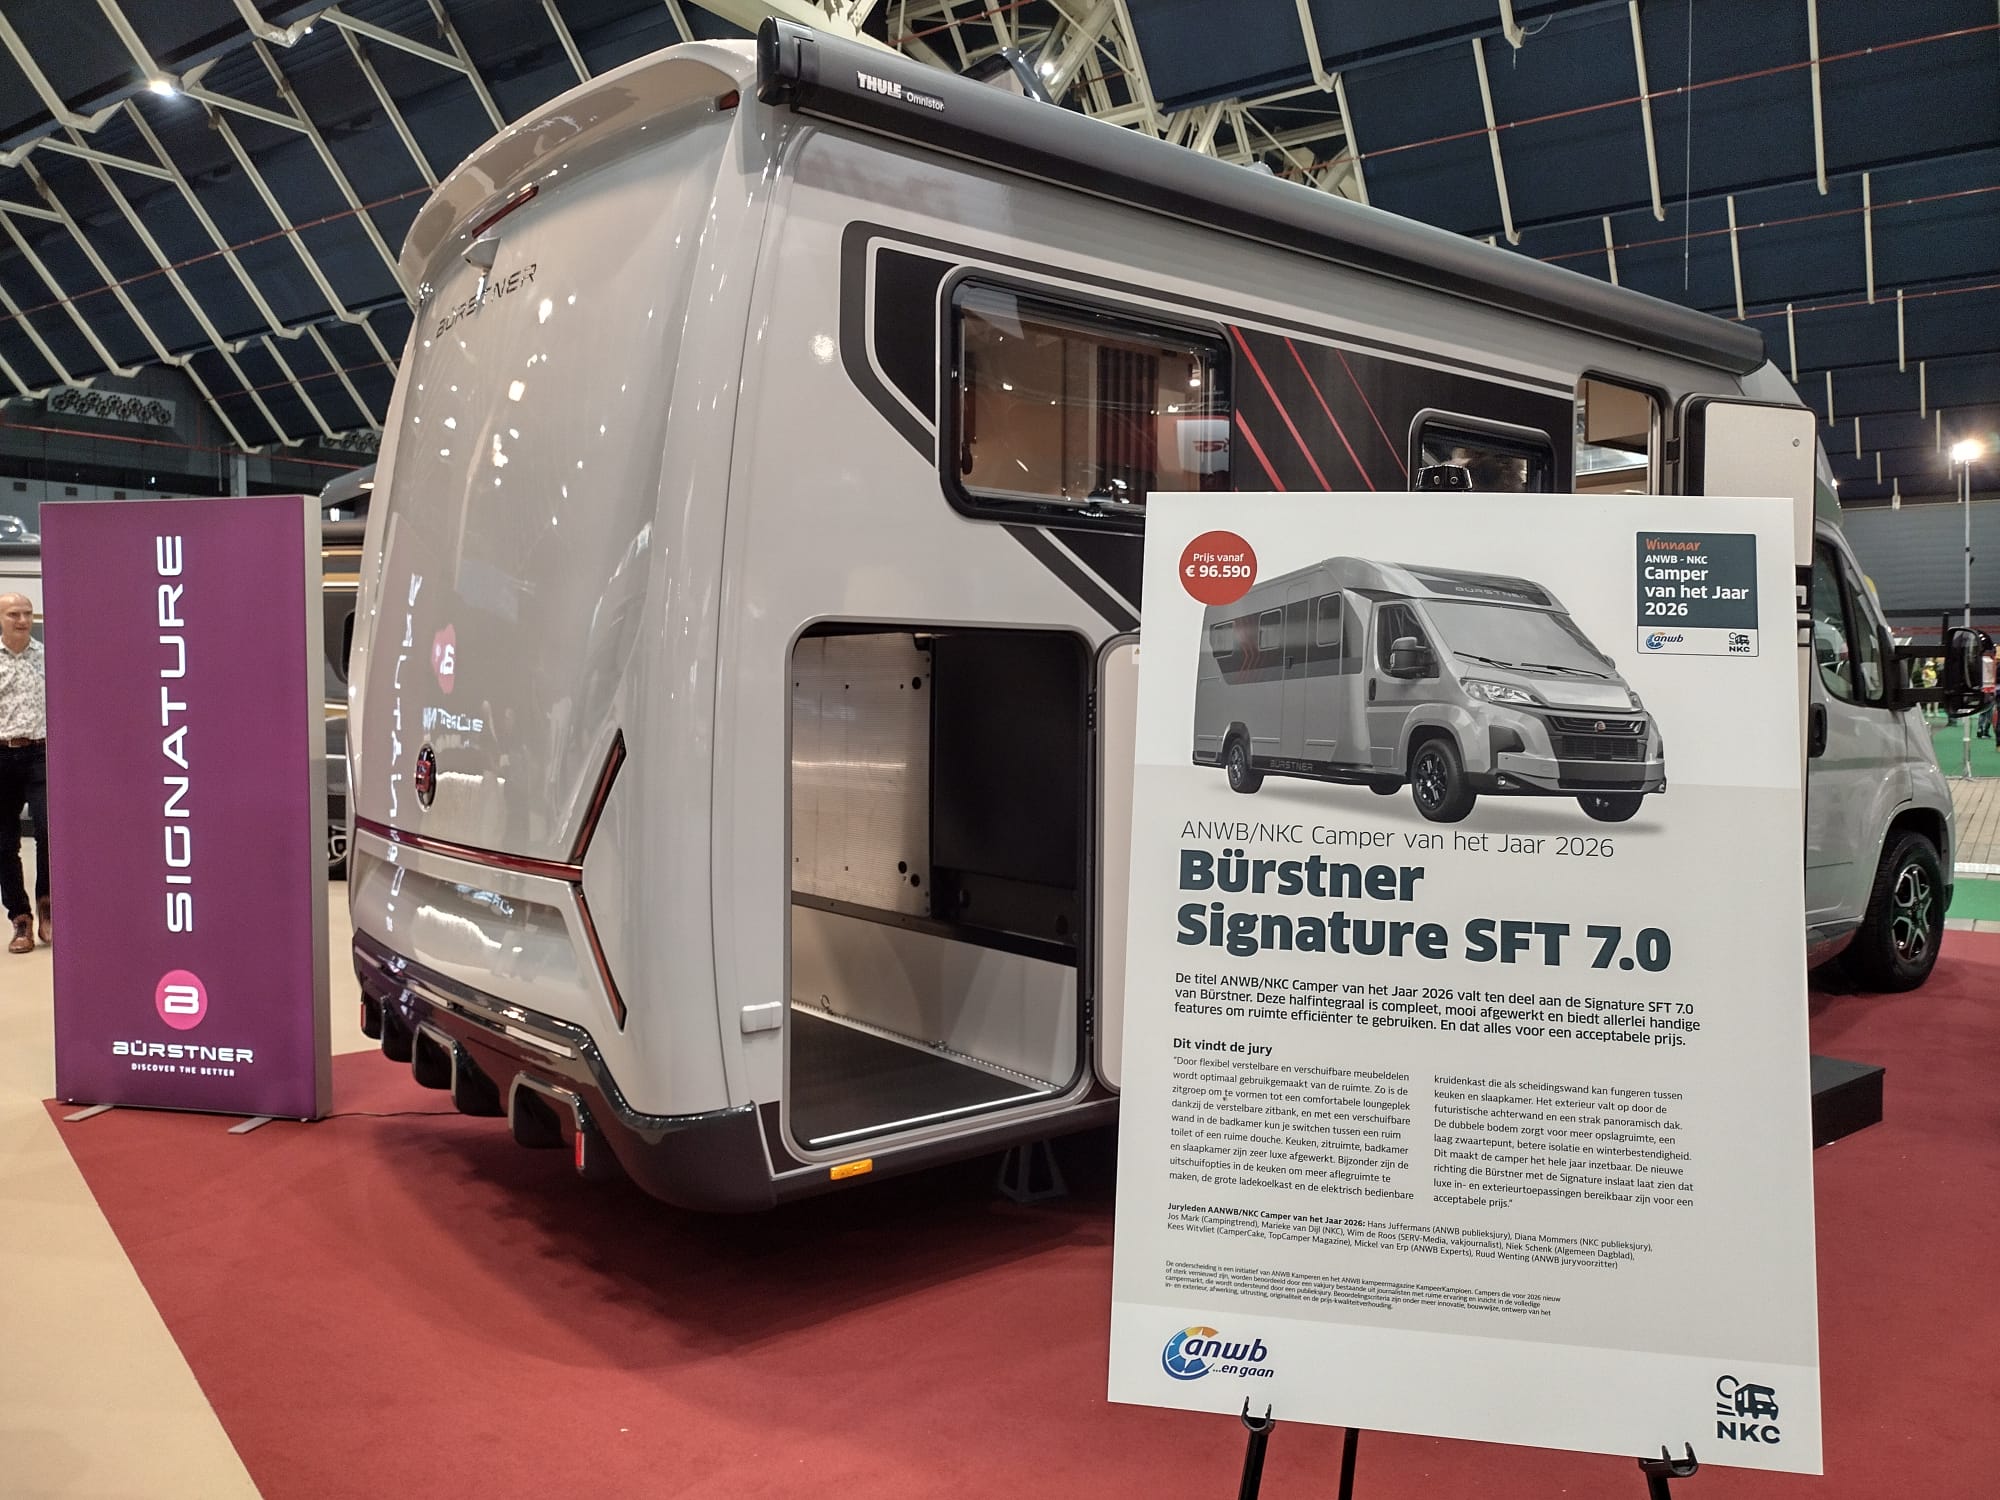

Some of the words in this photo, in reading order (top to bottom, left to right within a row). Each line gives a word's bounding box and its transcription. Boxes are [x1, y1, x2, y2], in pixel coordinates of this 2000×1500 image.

[857, 70, 902, 98] THULE
[907, 92, 944, 111] Omnistor
[1645, 538, 1701, 551] Winnaar
[1193, 553, 1215, 563] Prijs
[1216, 553, 1244, 562] vanaf
[1644, 555, 1678, 564] ANWB
[1686, 556, 1708, 564] NKC
[1185, 565, 1195, 578] €
[1200, 565, 1251, 578] 96.590
[1644, 566, 1708, 582] Camper
[1644, 586, 1676, 598] van
[1680, 585, 1708, 598] het
[1712, 586, 1749, 600] Jaar
[1645, 603, 1688, 616] 2026
[1654, 634, 1684, 643] anwb
[157, 535, 194, 934] SIGNATURE
[1180, 820, 1304, 844] ANWB/NKC
[1311, 825, 1395, 849] Camper
[1403, 832, 1444, 850] van
[1454, 830, 1489, 852] het
[1496, 834, 1546, 854] Jaar
[1555, 836, 1614, 858] 2026
[1179, 848, 1425, 902] Bürstner
[1176, 901, 1449, 960] Signature
[1464, 917, 1570, 966] SFT
[1586, 924, 1671, 972] 7.0
[1175, 972, 1192, 984] De
[1194, 972, 1217, 985] titel
[1219, 975, 1289, 990] ANWB/NKC
[1291, 979, 1339, 994] Camper
[1341, 984, 1365, 995] van
[1368, 983, 1389, 996] het
[1391, 985, 1419, 998] Jaar
[1421, 987, 1454, 1000] 2026
[1456, 990, 1482, 1002] valt
[1484, 991, 1505, 1004] ten
[1508, 992, 1535, 1005] deel
[1538, 996, 1562, 1007] aan
[1564, 995, 1581, 1008] de
[1584, 997, 1645, 1012] Signature
[1647, 1000, 1672, 1014] SFT
[1674, 1002, 1694, 1015] 7.0
[1174, 988, 1197, 999] van
[1200, 988, 1253, 1003] Bürstner.
[1256, 991, 1286, 1005] Deze
[1288, 993, 1365, 1010] halfintegraal
[1368, 998, 1379, 1011] is
[1381, 1001, 1442, 1017] compleet,
[1444, 1005, 1476, 1017] mooi
[1479, 1006, 1545, 1022] afgewerkt
[1547, 1012, 1564, 1023] en
[1567, 1011, 1600, 1025] biedt
[1602, 1013, 1646, 1028] allerlei
[1649, 1016, 1701, 1032] handige
[1174, 1001, 1223, 1016] features
[1225, 1007, 1245, 1017] om
[1248, 1006, 1288, 1020] ruimte
[1290, 1009, 1354, 1024] efficiënter
[1356, 1013, 1369, 1025] te
[1371, 1014, 1437, 1030] gebruiken.
[1440, 1018, 1456, 1031] En
[1459, 1020, 1481, 1033] dat
[1483, 1021, 1512, 1035] alles
[1514, 1026, 1546, 1037] voor
[1548, 1028, 1572, 1039] een
[1575, 1029, 1651, 1044] acceptabele
[1654, 1033, 1686, 1047] prijs.
[112, 1040, 254, 1063] BÜRSTNER
[1173, 1037, 1192, 1049] Dit
[1194, 1039, 1227, 1052] vindt
[1229, 1041, 1245, 1053] de
[1246, 1042, 1273, 1057] jury
[131, 1063, 175, 1073] DISCOVER
[200, 1068, 235, 1077] BETTER
[1199, 1057, 1230, 1068] flexibel
[1231, 1061, 1279, 1072] verstelbare
[1280, 1065, 1292, 1073] en
[1293, 1065, 1352, 1077] verschuifbare
[1353, 1069, 1410, 1081] meubeldelen
[1172, 1071, 1198, 1080] wordt
[1199, 1072, 1238, 1083] optimaal
[1238, 1074, 1308, 1089] gebruikgemaakt
[1310, 1081, 1327, 1090] van
[1328, 1081, 1340, 1091] de
[1341, 1082, 1372, 1093] ruimte.
[1373, 1084, 1386, 1094] Zo
[1387, 1085, 1395, 1095] is
[1396, 1086, 1408, 1096] de
[1434, 1074, 1486, 1087] kruidenkast
[1487, 1078, 1502, 1088] die
[1503, 1079, 1517, 1089] als
[1518, 1080, 1589, 1094] scheidingswand
[1591, 1085, 1608, 1095] kan
[1610, 1086, 1651, 1099] fungeren
[1653, 1090, 1683, 1100] tussen
[1171, 1084, 1207, 1097] zitgroep
[1208, 1088, 1222, 1096] om
[1224, 1088, 1234, 1097] te
[1235, 1090, 1268, 1100] vormen
[1269, 1091, 1283, 1101] tot
[1284, 1094, 1301, 1102] een
[1302, 1095, 1361, 1107] comfortabele
[1362, 1098, 1411, 1112] loungeplek
[1434, 1089, 1466, 1100] keuken
[1467, 1093, 1479, 1101] en
[1480, 1092, 1534, 1105] slaapkamer.
[1536, 1096, 1552, 1107] Het
[1554, 1099, 1596, 1109] exterieur
[1597, 1101, 1616, 1111] valt
[1616, 1103, 1630, 1113] op
[1631, 1102, 1654, 1113] door
[1654, 1104, 1667, 1114] de
[1433, 1103, 1489, 1117] futuristische
[1490, 1108, 1544, 1121] achterwand
[1545, 1113, 1557, 1122] en
[1559, 1114, 1576, 1123] een
[1578, 1114, 1601, 1125] strak
[1603, 1118, 1661, 1129] panoramisch
[1663, 1120, 1683, 1130] dak.
[1433, 1194, 1487, 1206] acceptabele
[1167, 1202, 1206, 1213] Juryleden
[1207, 1205, 1259, 1218] AANWB/NKC
[1259, 1210, 1292, 1221] Camper
[1309, 1214, 1324, 1224] het
[1324, 1216, 1343, 1225] Jaar
[1343, 1218, 1366, 1227] 2026:
[1367, 1220, 1387, 1229] Hans
[1387, 1222, 1431, 1233] Juffermans
[1432, 1225, 1460, 1235] (ANWB
[1514, 1232, 1537, 1242] Diana
[1538, 1234, 1578, 1245] Mommers
[1579, 1237, 1599, 1247] (NKC
[1184, 1339, 1268, 1362] anwb
[1239, 1366, 1274, 1378] gaan
[1717, 1421, 1780, 1444] NKC
